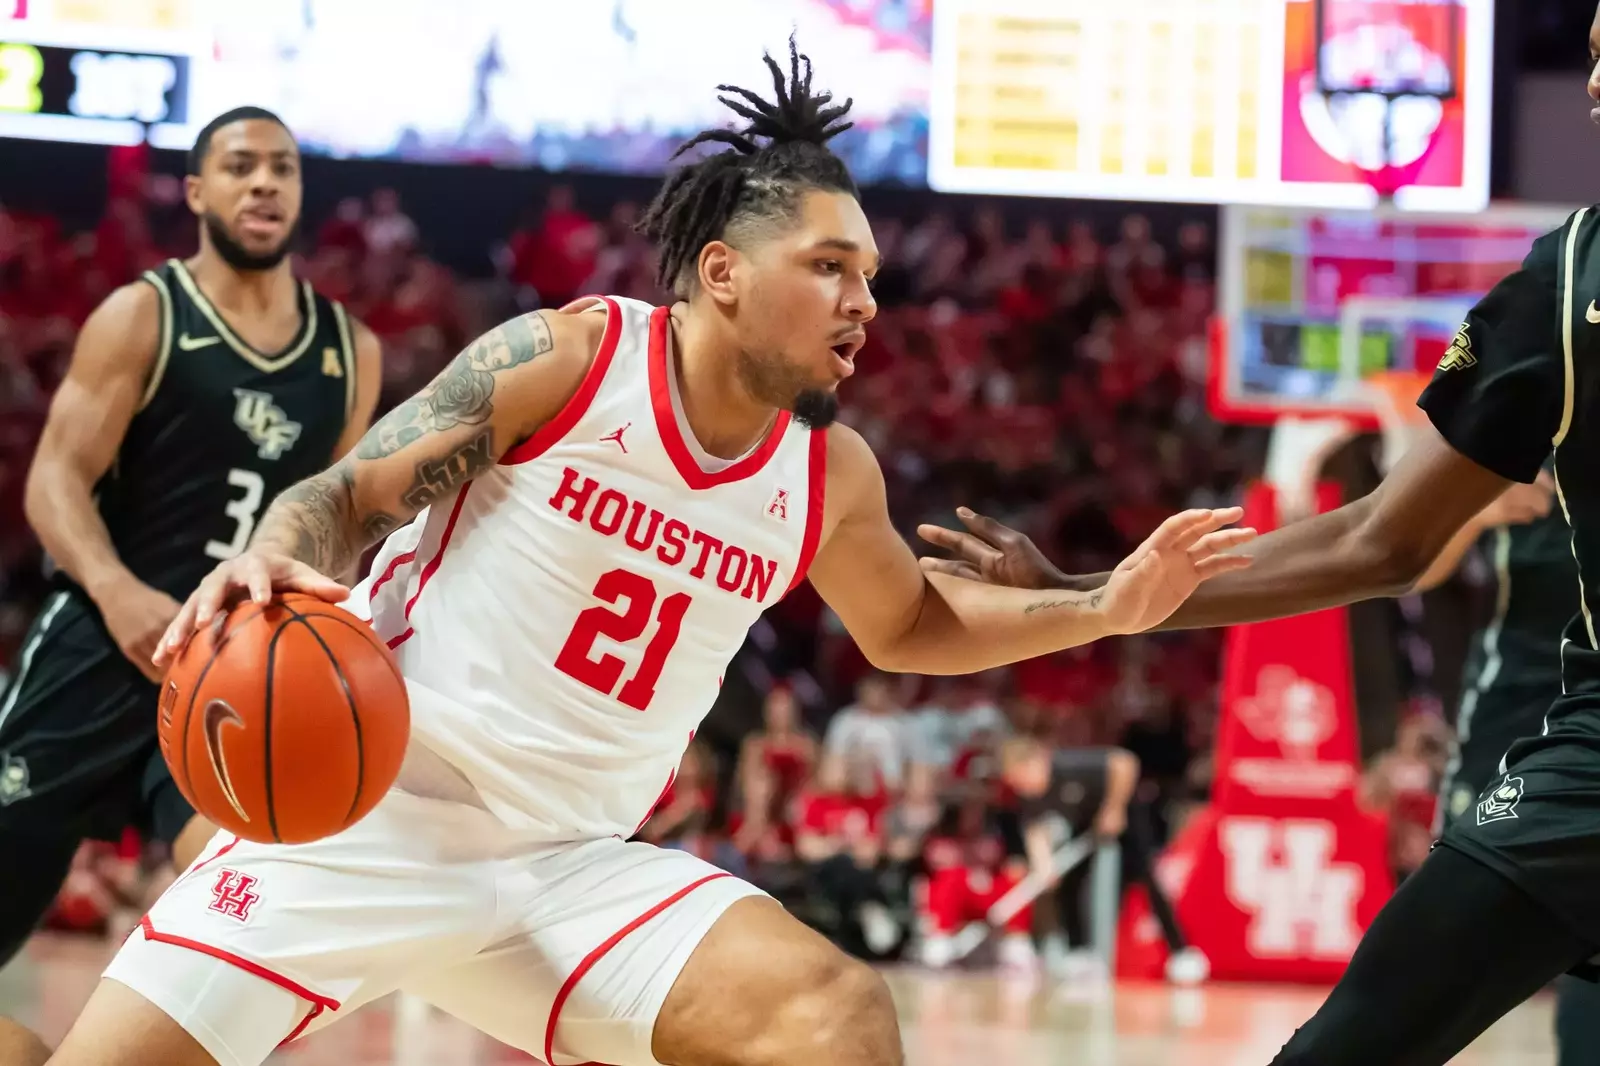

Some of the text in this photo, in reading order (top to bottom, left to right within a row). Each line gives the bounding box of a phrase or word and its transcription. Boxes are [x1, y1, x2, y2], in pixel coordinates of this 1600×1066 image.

[232, 387, 303, 460] UCF
[204, 468, 265, 560] 3
[548, 466, 778, 603] HOUSTON
[554, 568, 693, 711] 21
[208, 867, 259, 922] UH
[1217, 814, 1366, 962] UH
